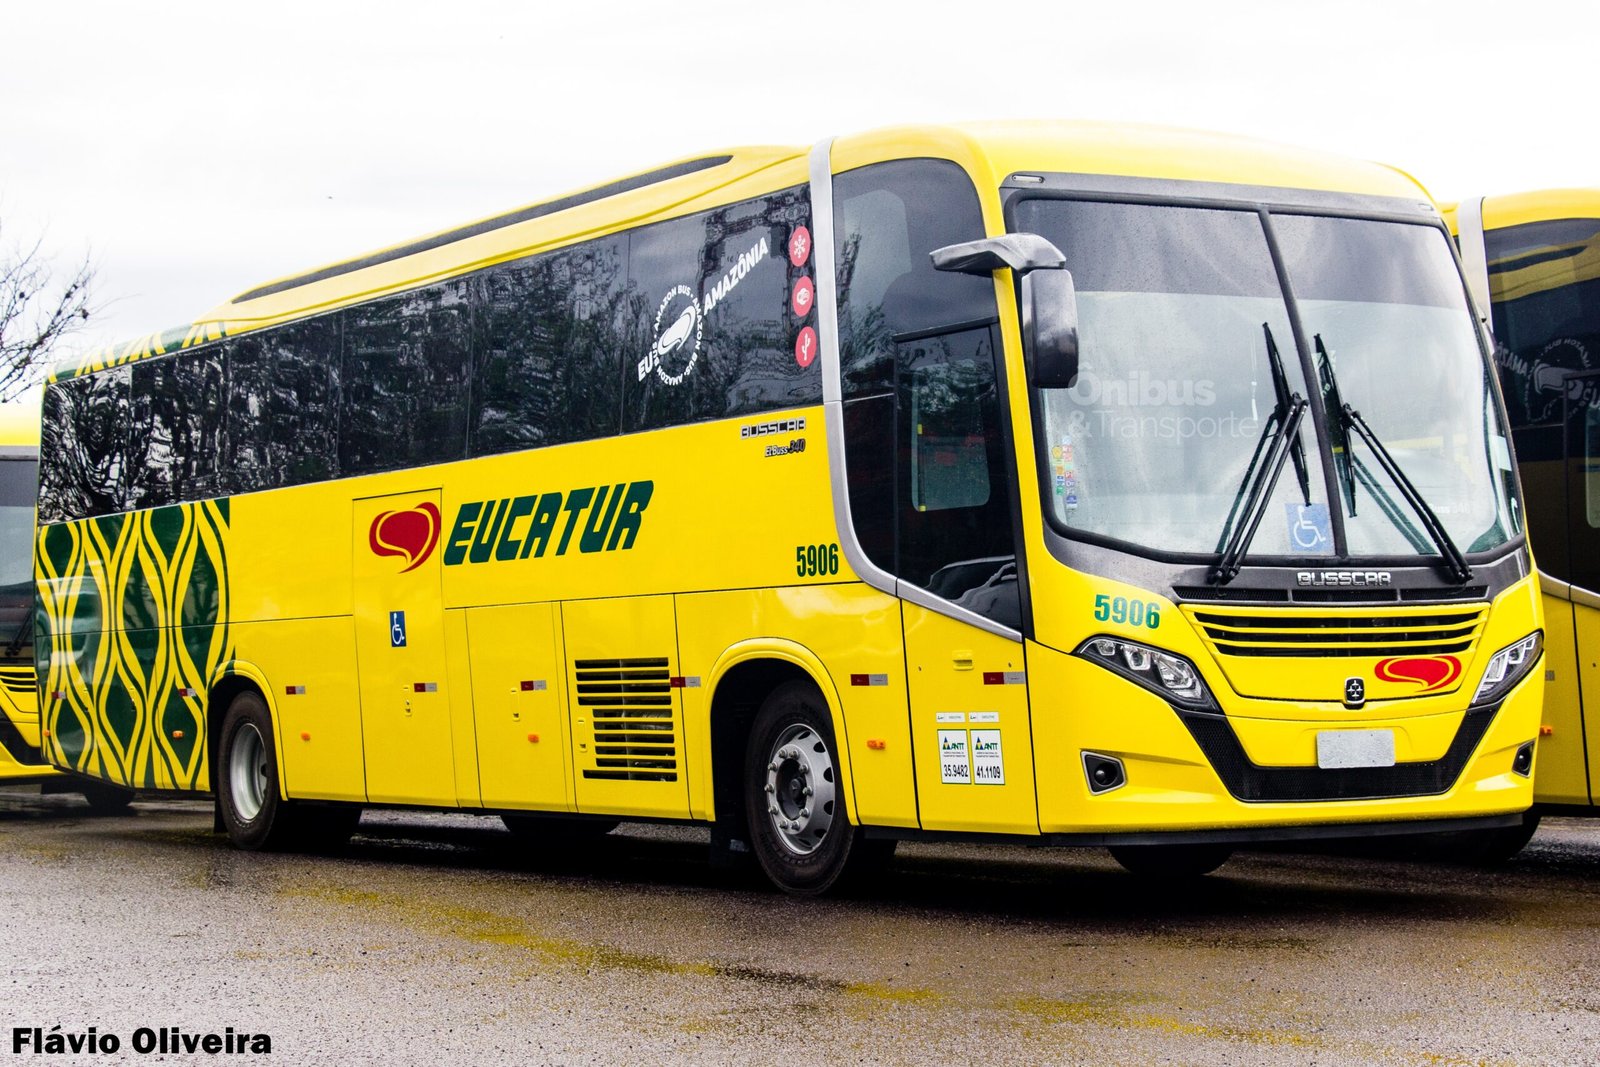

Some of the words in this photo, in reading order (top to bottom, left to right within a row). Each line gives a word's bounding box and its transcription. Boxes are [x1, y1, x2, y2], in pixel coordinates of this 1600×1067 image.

[704, 237, 769, 316] AMAZÔNIA
[654, 287, 677, 331] AMAZON
[677, 284, 691, 296] BUS
[692, 297, 703, 350] AMAZON
[638, 351, 654, 382] EU
[657, 365, 683, 386] AMAZON
[685, 352, 698, 375] BUS
[741, 418, 805, 438] BUSSCAR
[789, 438, 806, 454] 340
[443, 479, 655, 566] EUCATUR
[796, 543, 839, 577] 5906
[1297, 572, 1392, 586] BUSSCAR
[1094, 594, 1161, 629] 5906
[943, 764, 969, 778] 35.9482
[976, 765, 1001, 779] 41.1109
